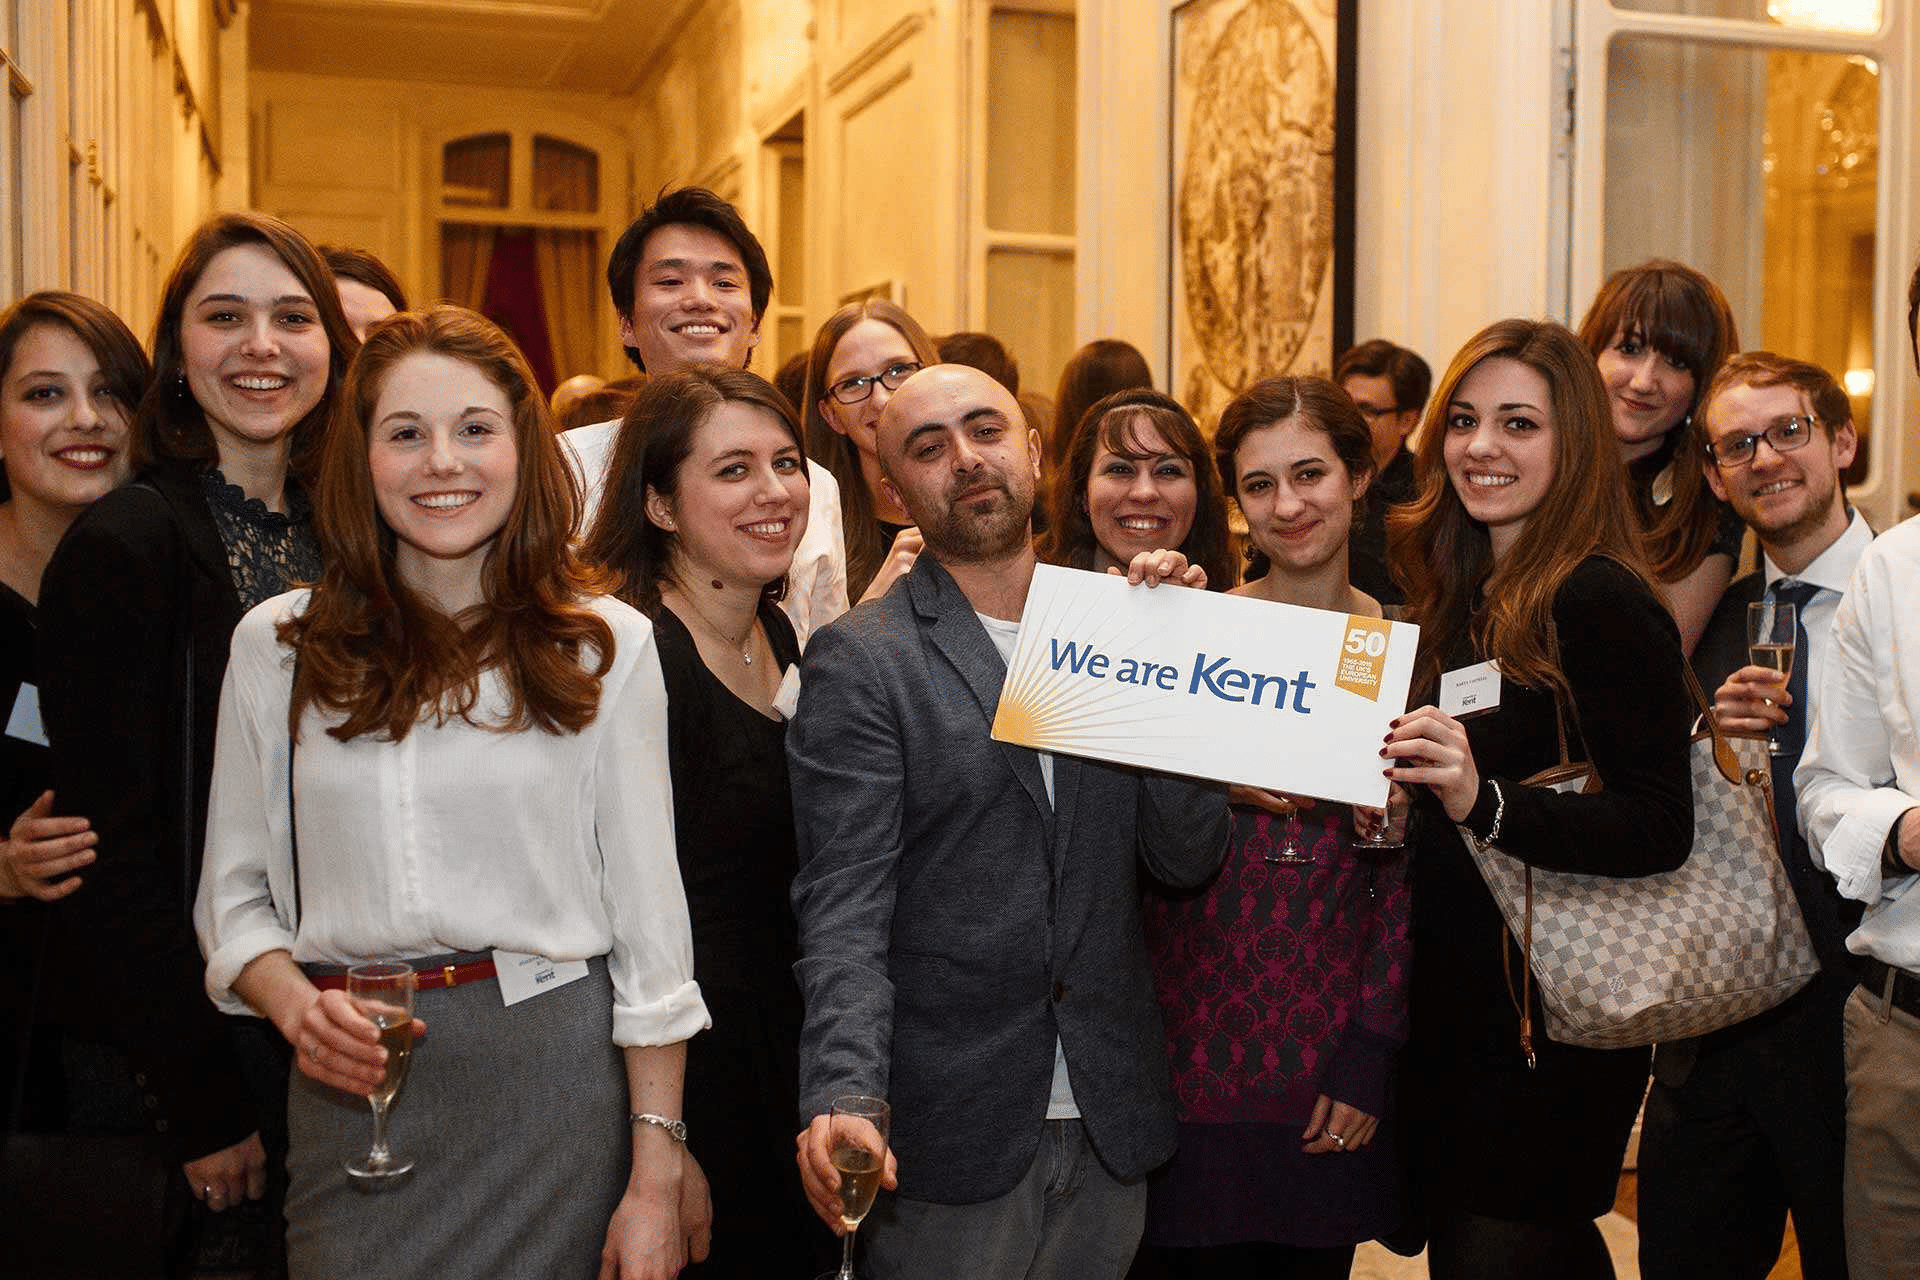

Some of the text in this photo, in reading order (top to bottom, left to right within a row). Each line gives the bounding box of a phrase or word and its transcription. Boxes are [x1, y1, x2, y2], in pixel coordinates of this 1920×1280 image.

[1344, 628, 1385, 657] 50
[1051, 639, 1316, 713] We are Kent
[1339, 674, 1376, 685] UNIVERSITY
[1340, 669, 1376, 680] EUROPEAN
